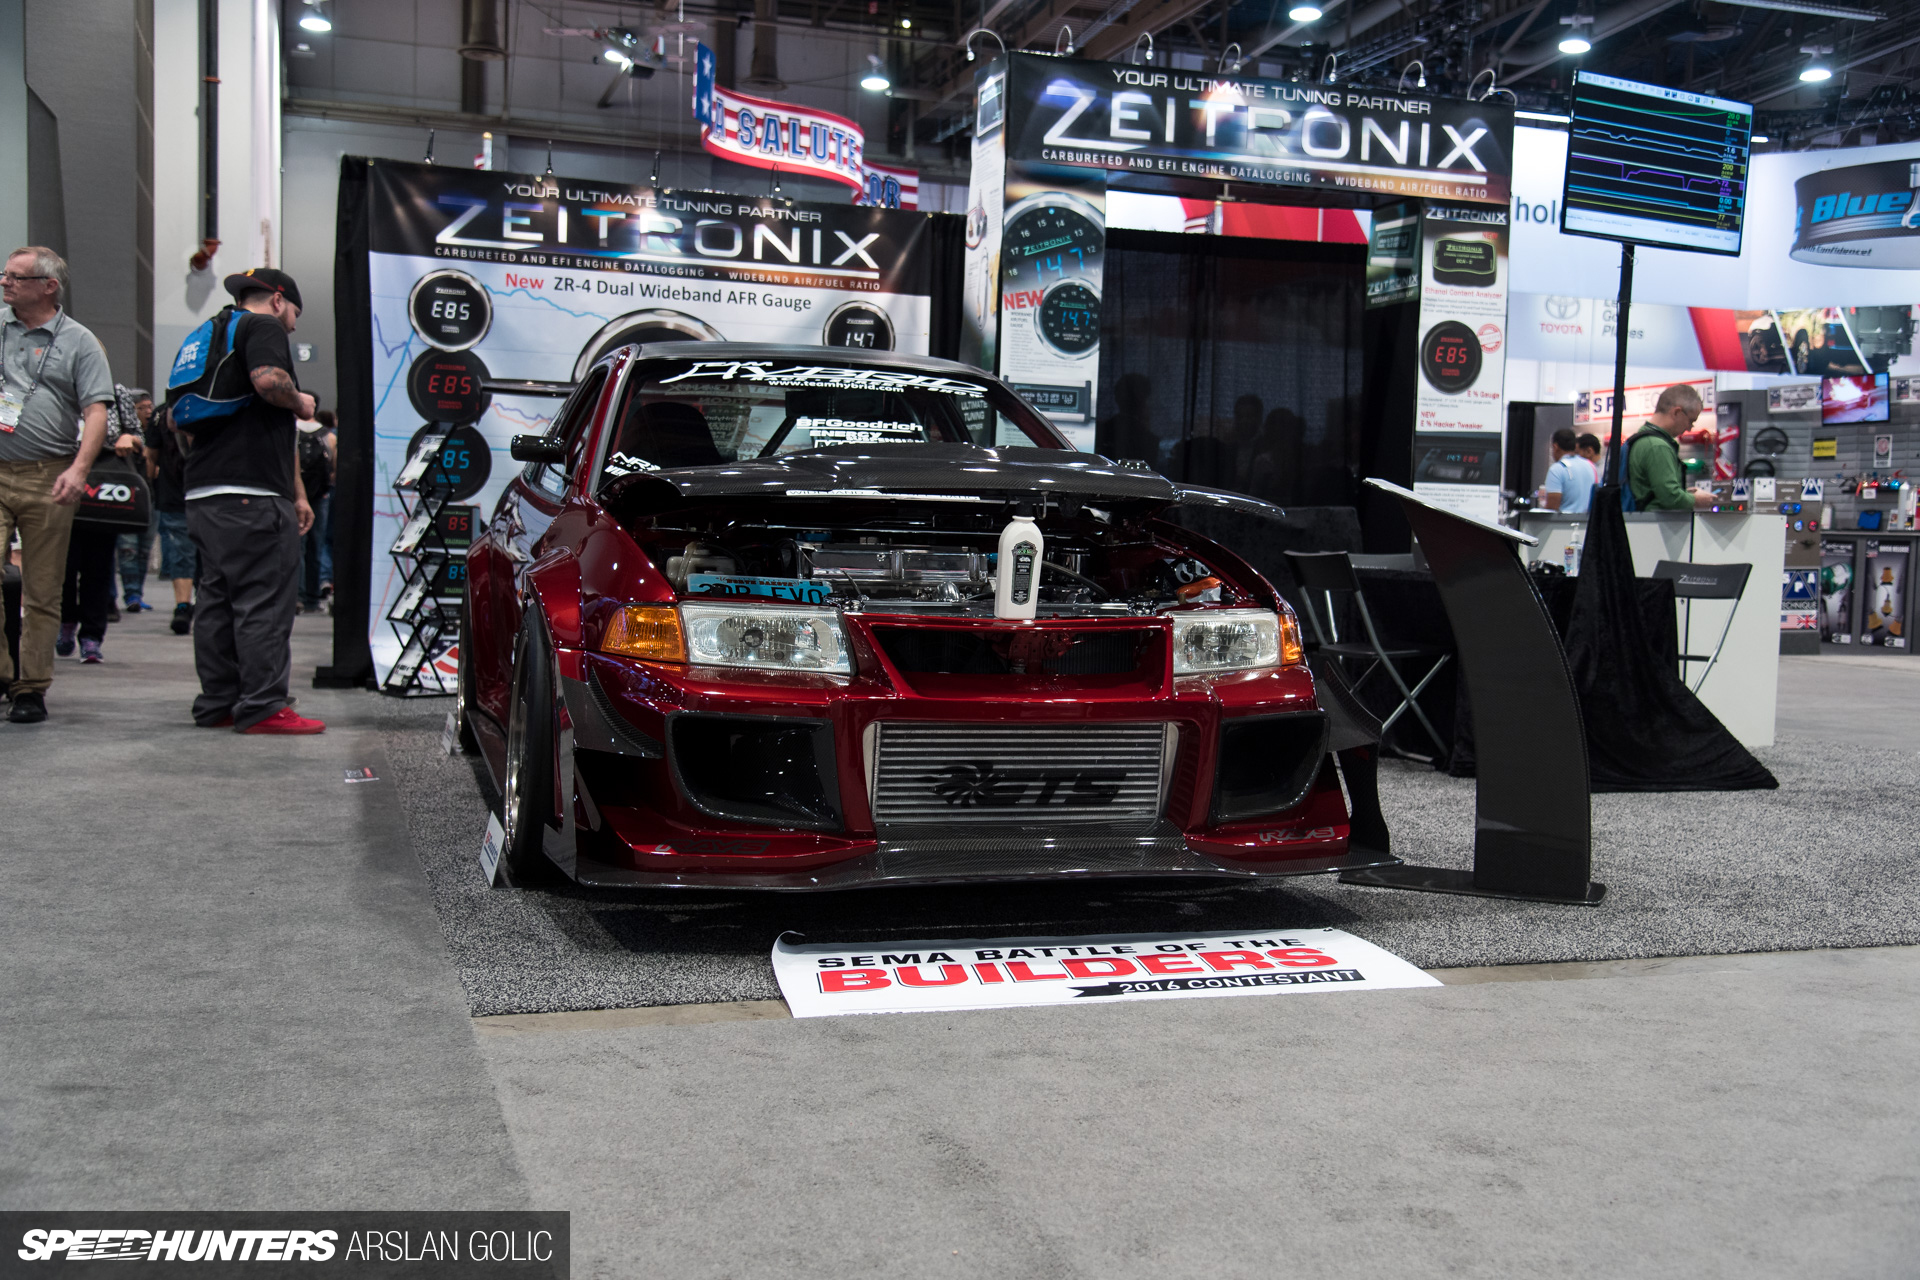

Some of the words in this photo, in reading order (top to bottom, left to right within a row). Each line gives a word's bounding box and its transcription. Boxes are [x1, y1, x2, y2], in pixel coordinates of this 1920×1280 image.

[1112, 68, 1168, 88] YOUR
[1174, 77, 1266, 98] ULTIMATE
[1271, 86, 1341, 106] TUNING
[1347, 96, 1431, 115] PARTNER
[712, 97, 726, 142] A
[736, 107, 858, 176] SALUTE
[1043, 86, 1488, 172] ZEITRONIX
[1042, 149, 1123, 166] CARBURETED
[1129, 157, 1153, 169] AND
[1158, 160, 1177, 171] EFI
[1182, 162, 1225, 176] ENGINE
[1230, 167, 1311, 183] DATALOGGING
[1335, 176, 1394, 190] WIDEBAND
[1400, 182, 1450, 196] AIR/FUEL
[1455, 187, 1487, 199] RATIO
[503, 183, 560, 199] YOUR
[566, 189, 658, 208] ULTIMATE
[663, 199, 733, 216] TUNING
[738, 205, 822, 223] PARTNER
[1515, 196, 1562, 225] hol
[1811, 191, 1913, 224] Blue
[1037, 219, 1047, 228] 15
[1056, 218, 1065, 228] 14
[1425, 207, 1507, 225] ZEITRONIX
[435, 194, 880, 270] ZEITRONIX
[1021, 229, 1030, 238] 16
[1074, 229, 1084, 237] 13
[1010, 247, 1019, 255] 17
[1023, 234, 1073, 256] ZEITRONIX
[435, 246, 516, 262] CARBURETED
[522, 254, 547, 265] AND
[552, 257, 571, 267] EFI
[577, 259, 619, 271] ENGINE
[625, 262, 705, 277] DATALOGGING
[729, 271, 789, 284] WIDEBAND
[794, 276, 845, 288] AIR/FUEL
[850, 281, 881, 291] RATIO
[1008, 268, 1018, 277] 18
[505, 273, 545, 289] New
[554, 276, 592, 293] ZR-4
[597, 280, 634, 297] Dual
[640, 283, 722, 303] Wideband
[727, 290, 757, 305] AFR
[762, 293, 812, 311] Gauge
[1003, 289, 1044, 311] NEW
[1425, 287, 1447, 295] Ethanol
[1449, 289, 1474, 297] Content
[431, 300, 470, 320] E85
[1540, 323, 1583, 335] TOYOTA
[1435, 346, 1467, 364] E85
[428, 375, 471, 395] E85
[768, 379, 905, 393] www.teamhybrid.com
[961, 400, 988, 411] ULTIMATE
[796, 417, 923, 432] BFGoodrich
[964, 411, 985, 422] TUNING
[434, 451, 470, 469] 85
[1258, 826, 1336, 842] RAYS
[817, 952, 956, 969] SEMA
[975, 945, 1137, 960] BATTLE
[1155, 943, 1207, 952] OF
[1223, 938, 1306, 949] THE
[816, 947, 1338, 994] BUILDERS
[1119, 979, 1181, 993] 2016
[1188, 969, 1355, 989] CONTESTANT
